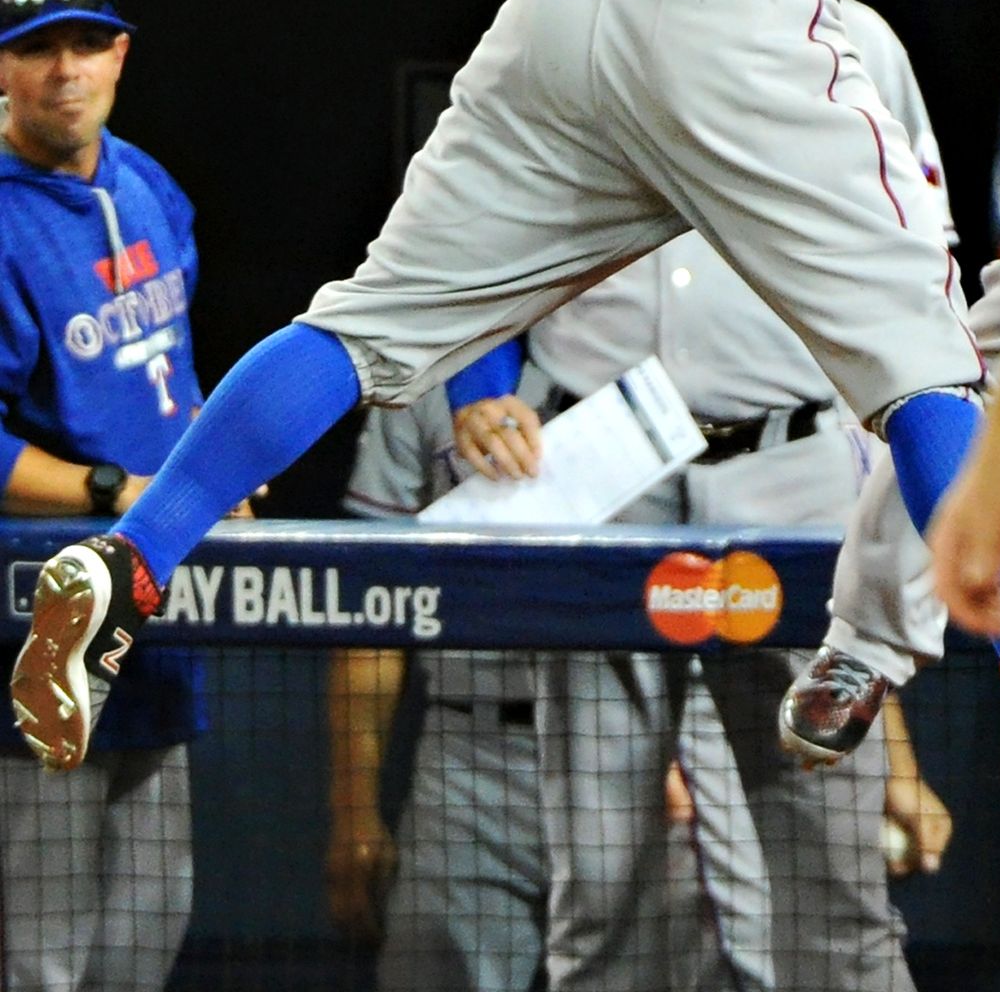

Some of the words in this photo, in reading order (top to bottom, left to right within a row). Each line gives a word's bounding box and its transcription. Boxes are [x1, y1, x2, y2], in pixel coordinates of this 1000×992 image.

[149, 566, 224, 624] AY
[232, 566, 441, 638] BALL.org
[648, 584, 777, 613] MasterCard
